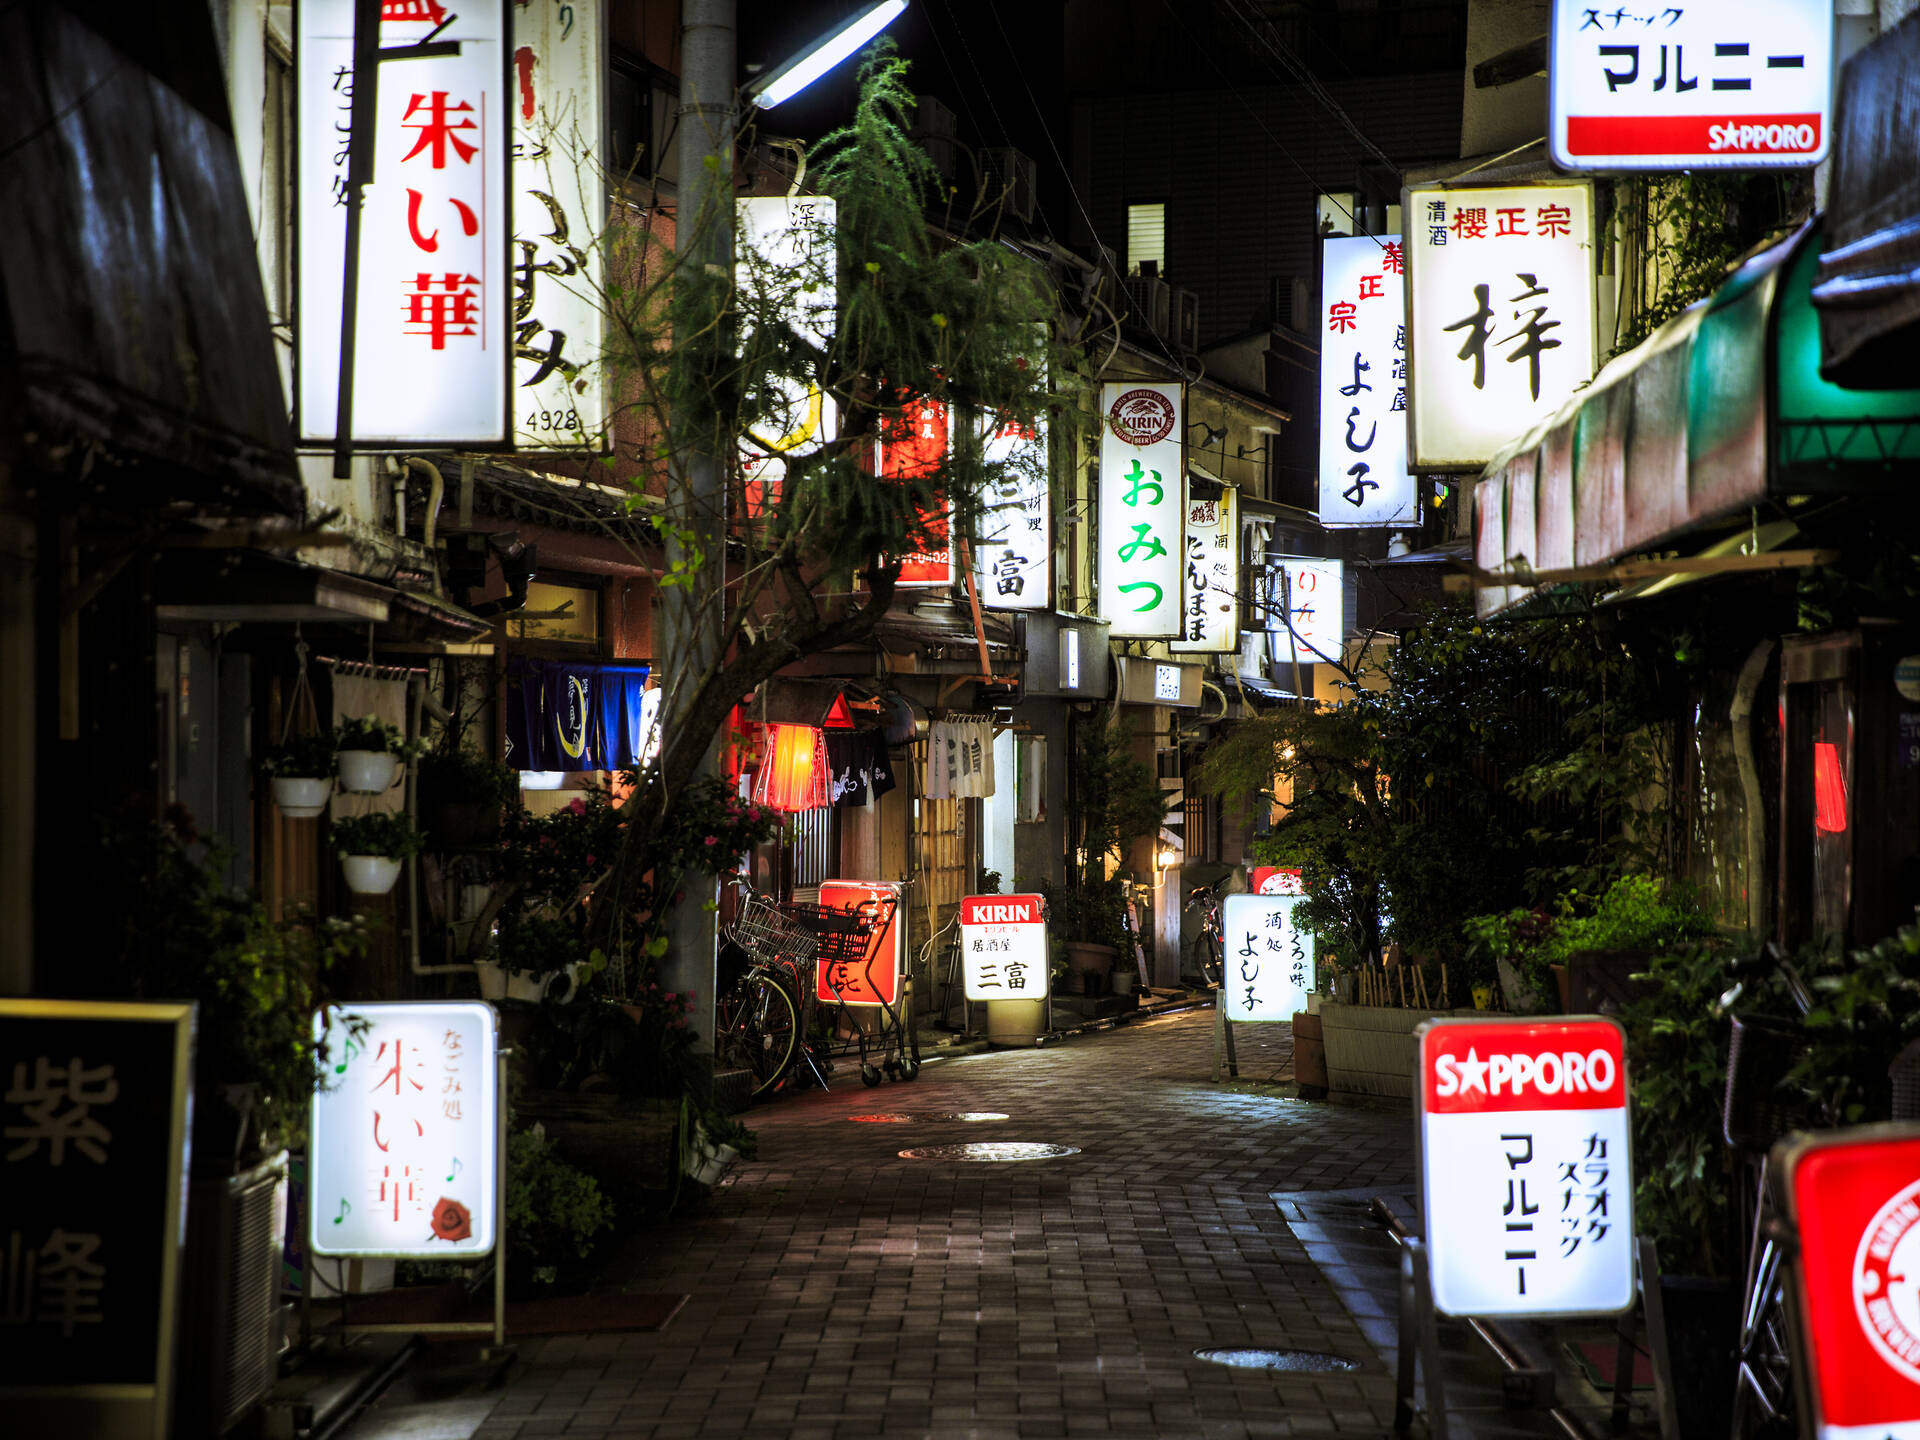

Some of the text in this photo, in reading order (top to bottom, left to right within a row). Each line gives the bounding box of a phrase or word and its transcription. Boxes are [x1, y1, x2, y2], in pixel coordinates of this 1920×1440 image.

[1579, 7, 1684, 31] スナック
[1598, 42, 1805, 93] マルニー
[400, 91, 480, 350] 朱い華
[1427, 201, 1448, 246] 清酒
[1442, 273, 1562, 402] 梓
[1122, 417, 1162, 429] KIRIN
[1339, 352, 1380, 508] よし子
[1117, 459, 1167, 612] おみつ
[972, 905, 1030, 923] KIRIN
[1265, 911, 1282, 952] 酒処
[977, 961, 1029, 989] 三富
[1238, 931, 1263, 1011] よし子
[441, 1028, 463, 1120] なごみ処
[368, 1038, 424, 1222] 朱い華
[1500, 1132, 1539, 1295] マルニー
[1559, 1161, 1582, 1258] スナック
[1584, 1132, 1611, 1243] カラオケ
